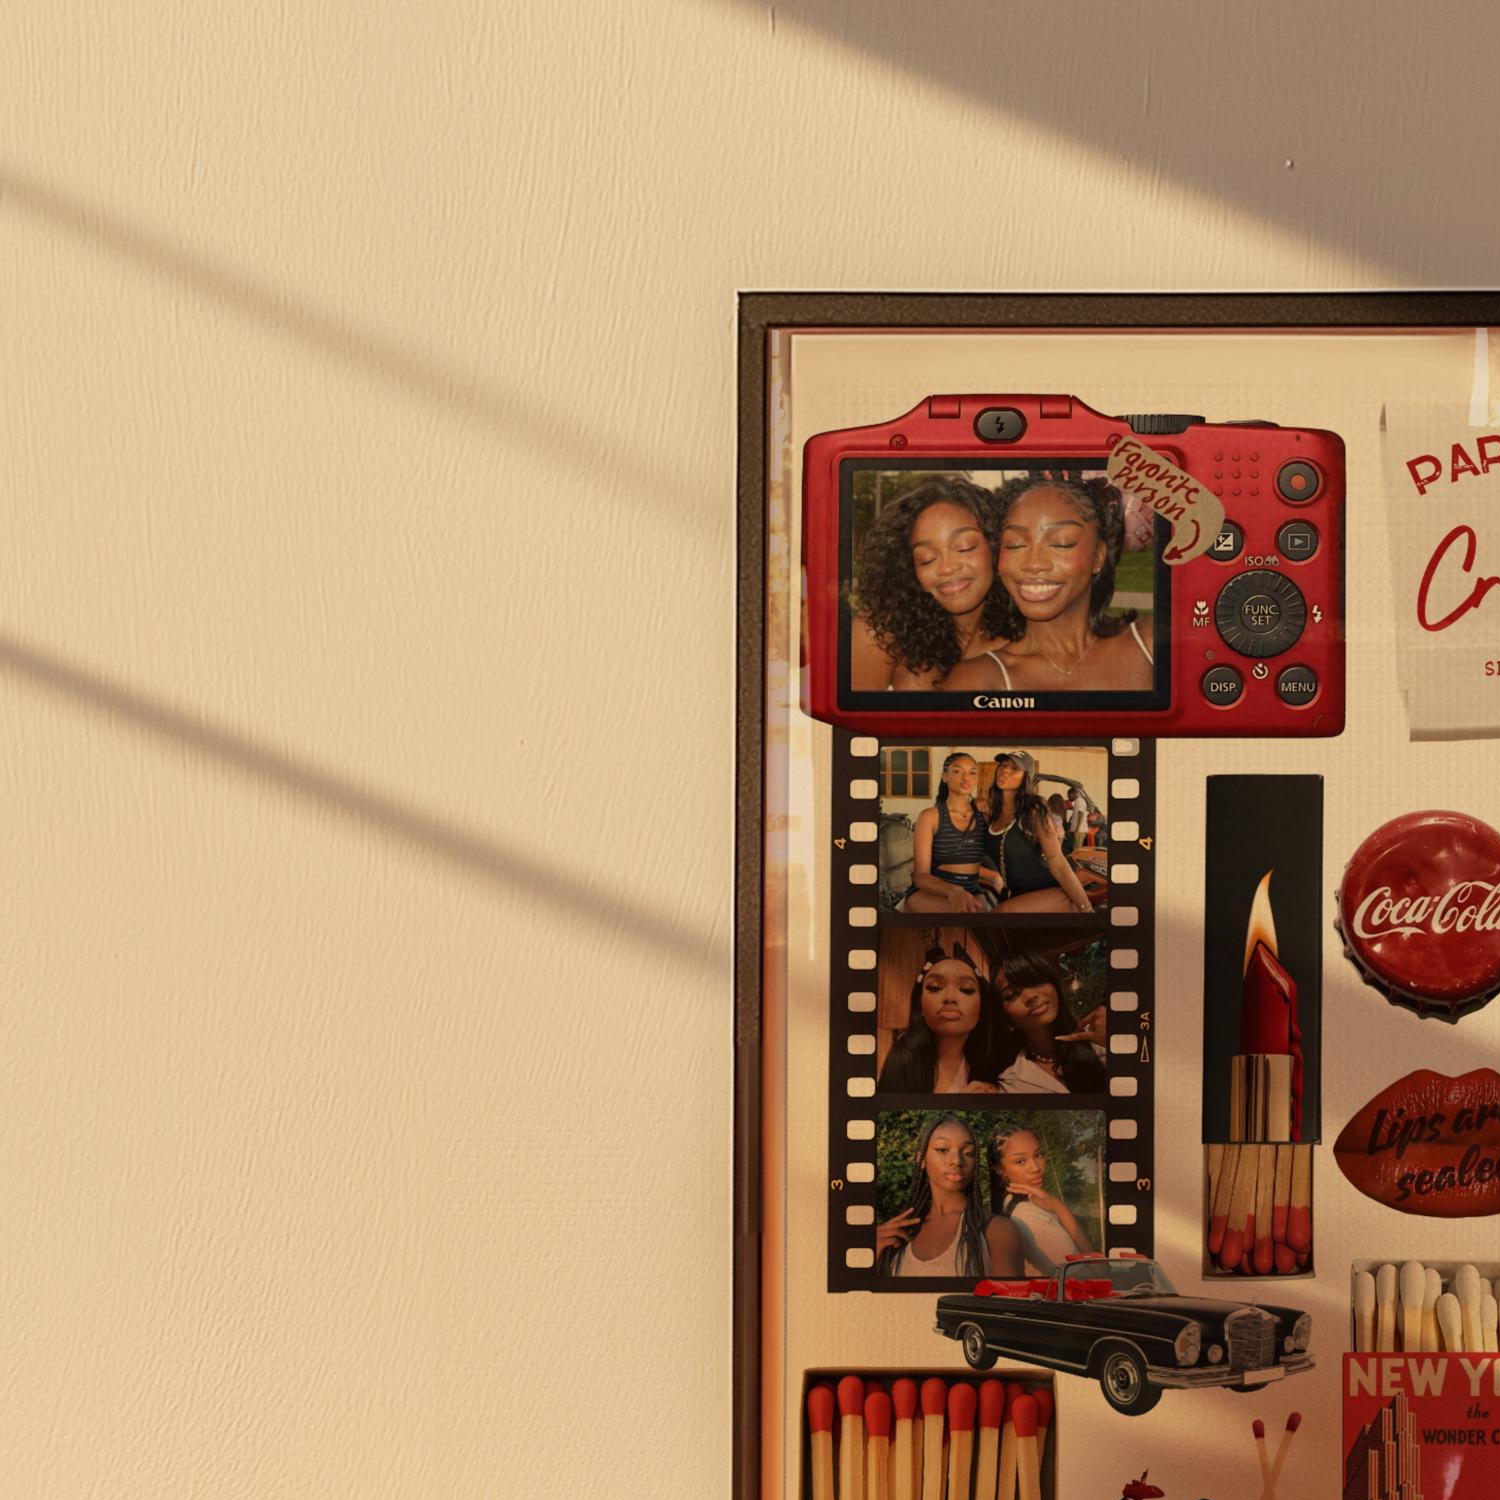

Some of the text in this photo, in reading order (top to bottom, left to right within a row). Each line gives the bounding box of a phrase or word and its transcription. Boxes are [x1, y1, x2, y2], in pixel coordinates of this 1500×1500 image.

[1245, 555, 1263, 566] ISO
[1245, 604, 1280, 615] FUNC.
[1193, 617, 1211, 627] MF
[1251, 615, 1272, 626] SET
[1210, 682, 1238, 692] DISP.
[1281, 682, 1316, 692] MENU
[973, 695, 1035, 709] Canon
[834, 838, 847, 850] 4
[1138, 836, 1153, 850] 4
[1367, 1106, 1446, 1160] Lips
[831, 1179, 844, 1191] 3
[1137, 1177, 1151, 1191] 3
[1349, 1358, 1448, 1397] NEW
[1466, 1402, 1489, 1419] the
[1422, 1428, 1487, 1445] WONDER
